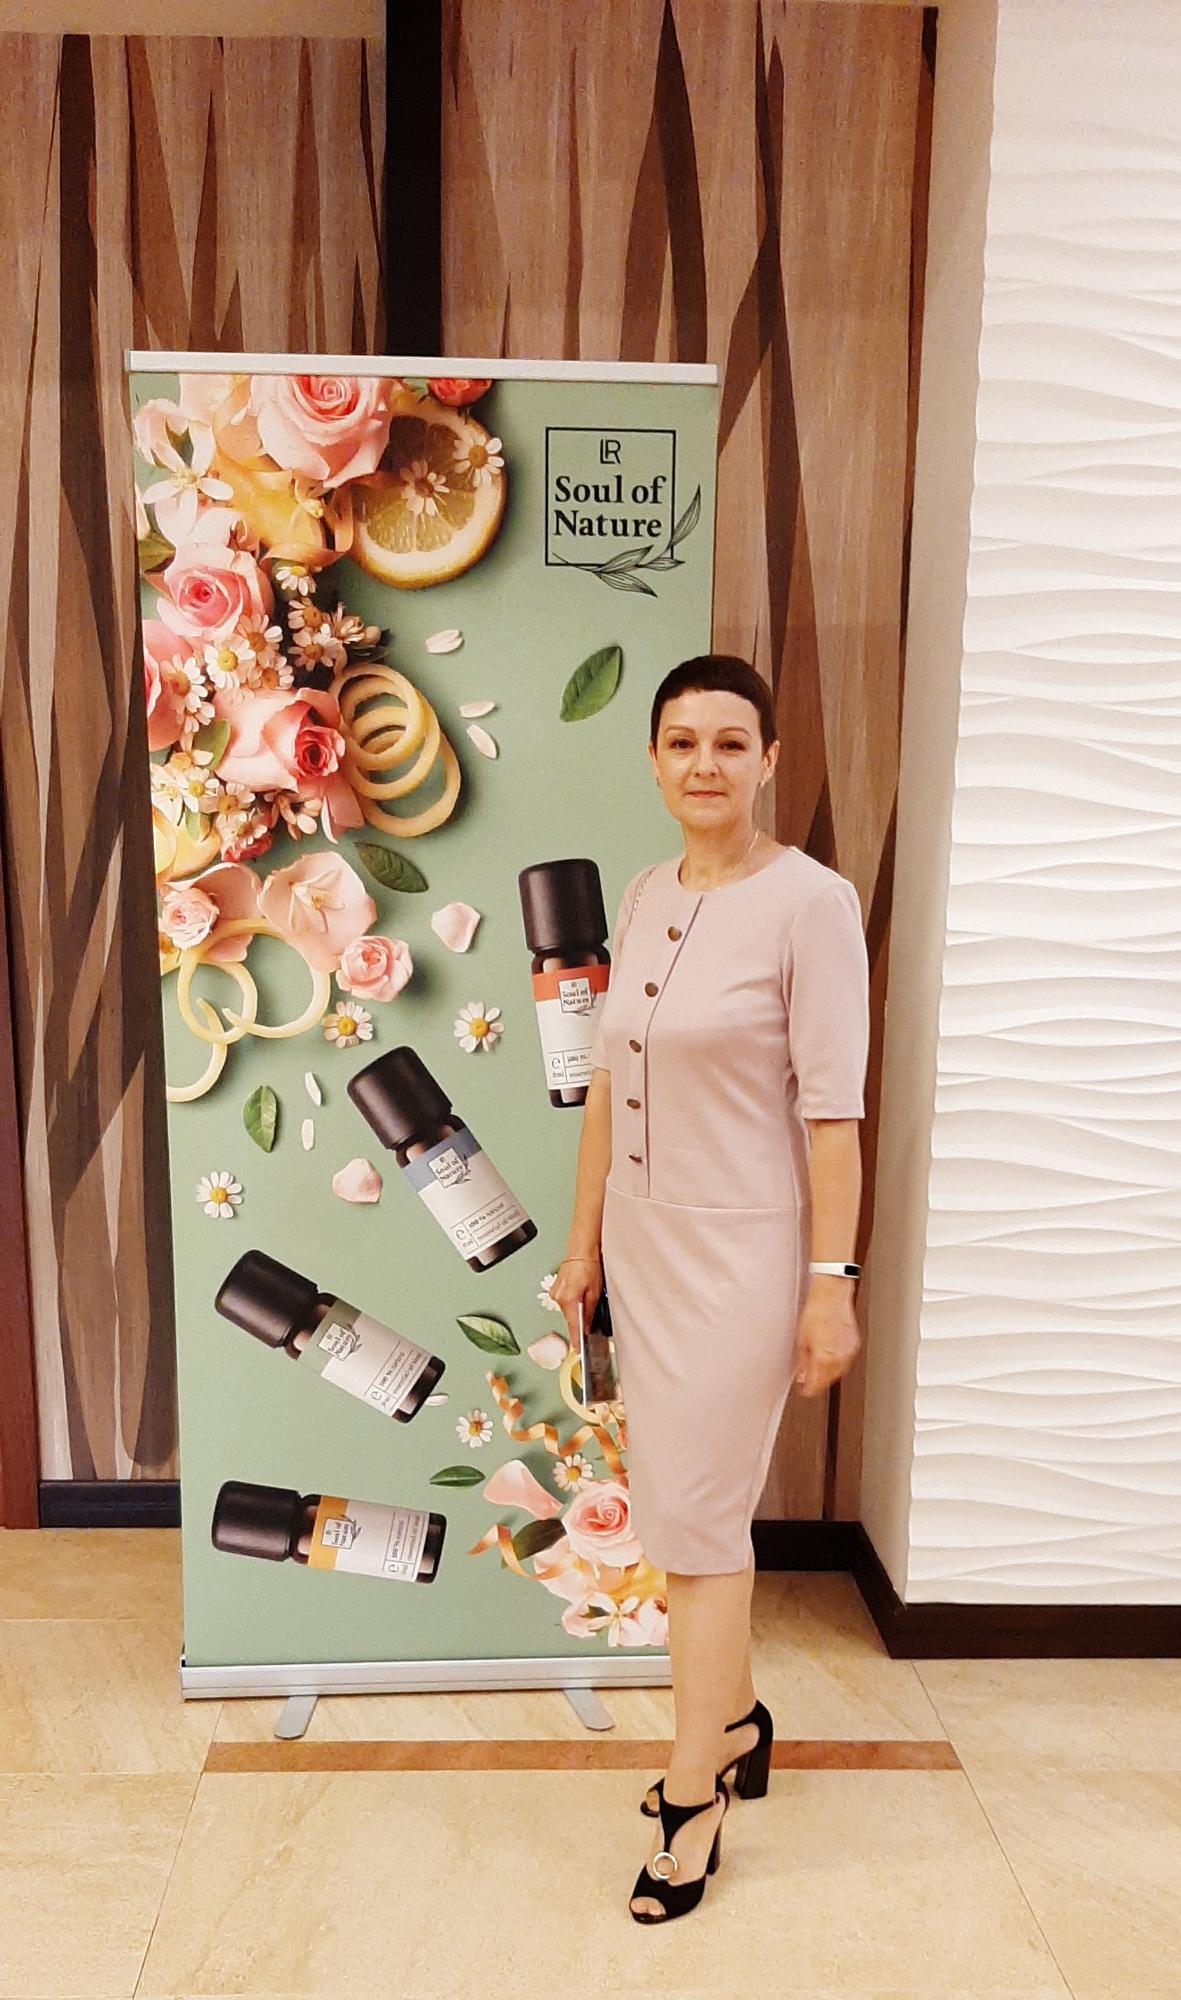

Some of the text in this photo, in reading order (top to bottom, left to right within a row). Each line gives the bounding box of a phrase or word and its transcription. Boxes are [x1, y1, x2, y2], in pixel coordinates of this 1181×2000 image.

[554, 475, 667, 504] Soul of
[553, 509, 662, 537] Nature
